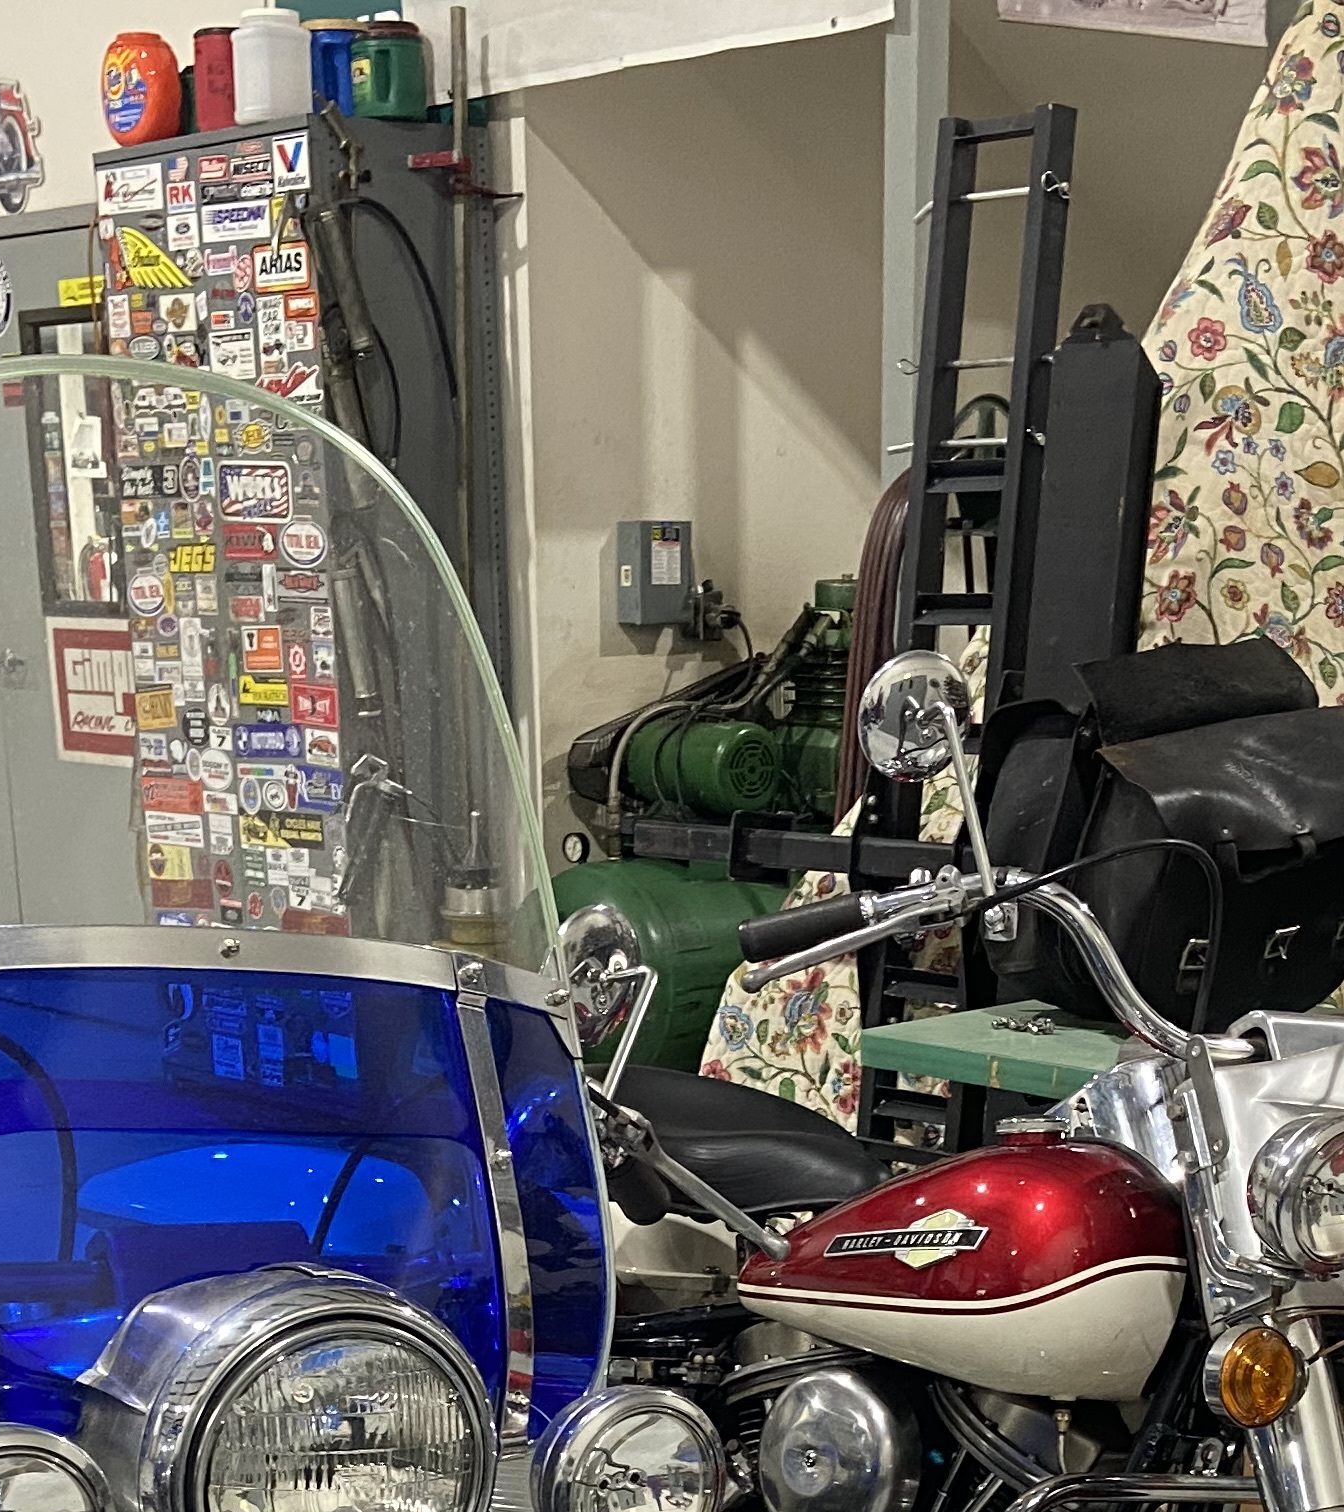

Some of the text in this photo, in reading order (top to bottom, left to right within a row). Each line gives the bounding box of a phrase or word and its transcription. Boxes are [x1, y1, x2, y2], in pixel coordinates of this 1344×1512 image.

[168, 185, 194, 205] RK
[258, 252, 304, 277] ARIAS
[72, 711, 116, 732] RACING
[216, 735, 227, 747] 7
[295, 895, 306, 906] 7
